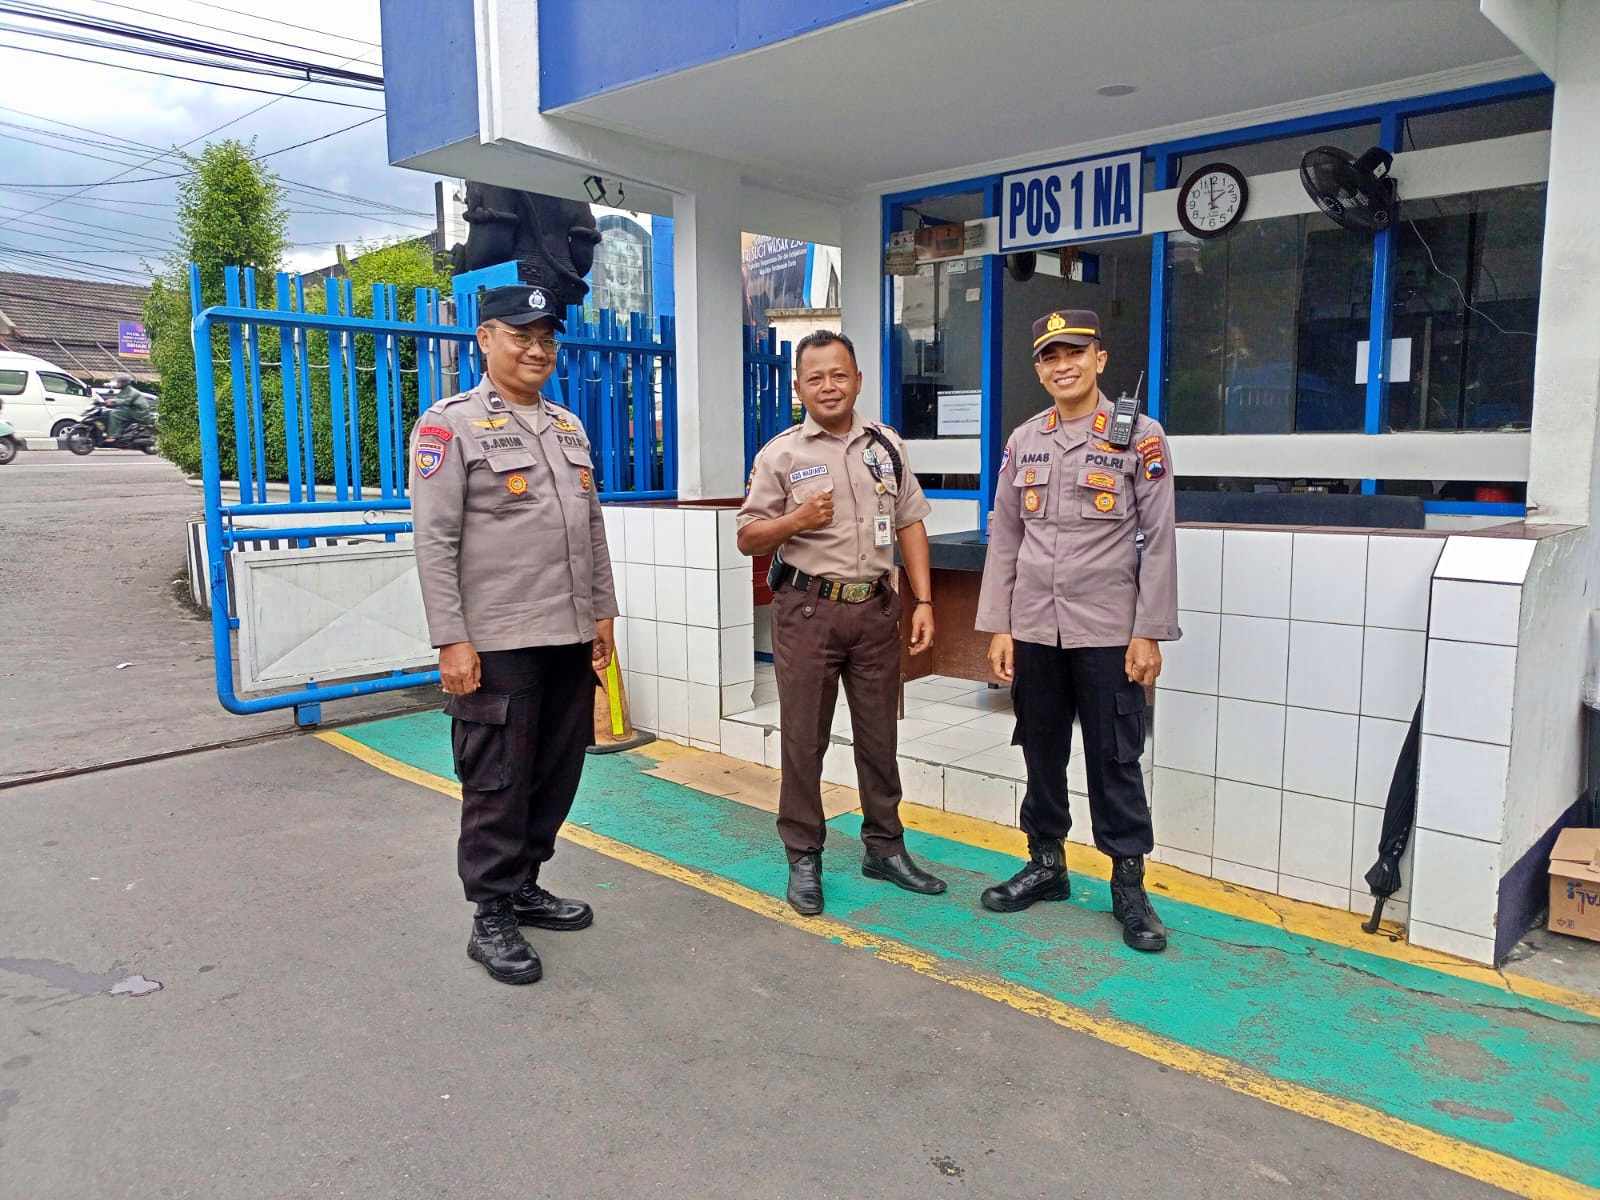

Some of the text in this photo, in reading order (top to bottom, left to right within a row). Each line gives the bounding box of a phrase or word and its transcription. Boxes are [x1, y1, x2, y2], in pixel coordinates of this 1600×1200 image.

[1227, 184, 1235, 193] 2
[1009, 162, 1132, 239] POS 1 NA
[1230, 193, 1238, 203] 3
[1190, 200, 1196, 209] 9
[1227, 204, 1233, 214] 4
[1192, 210, 1199, 219] 8
[1219, 213, 1226, 223] 5
[1199, 217, 1205, 227] 7
[1209, 218, 1216, 227] 6
[1085, 454, 1124, 469] POLRI
